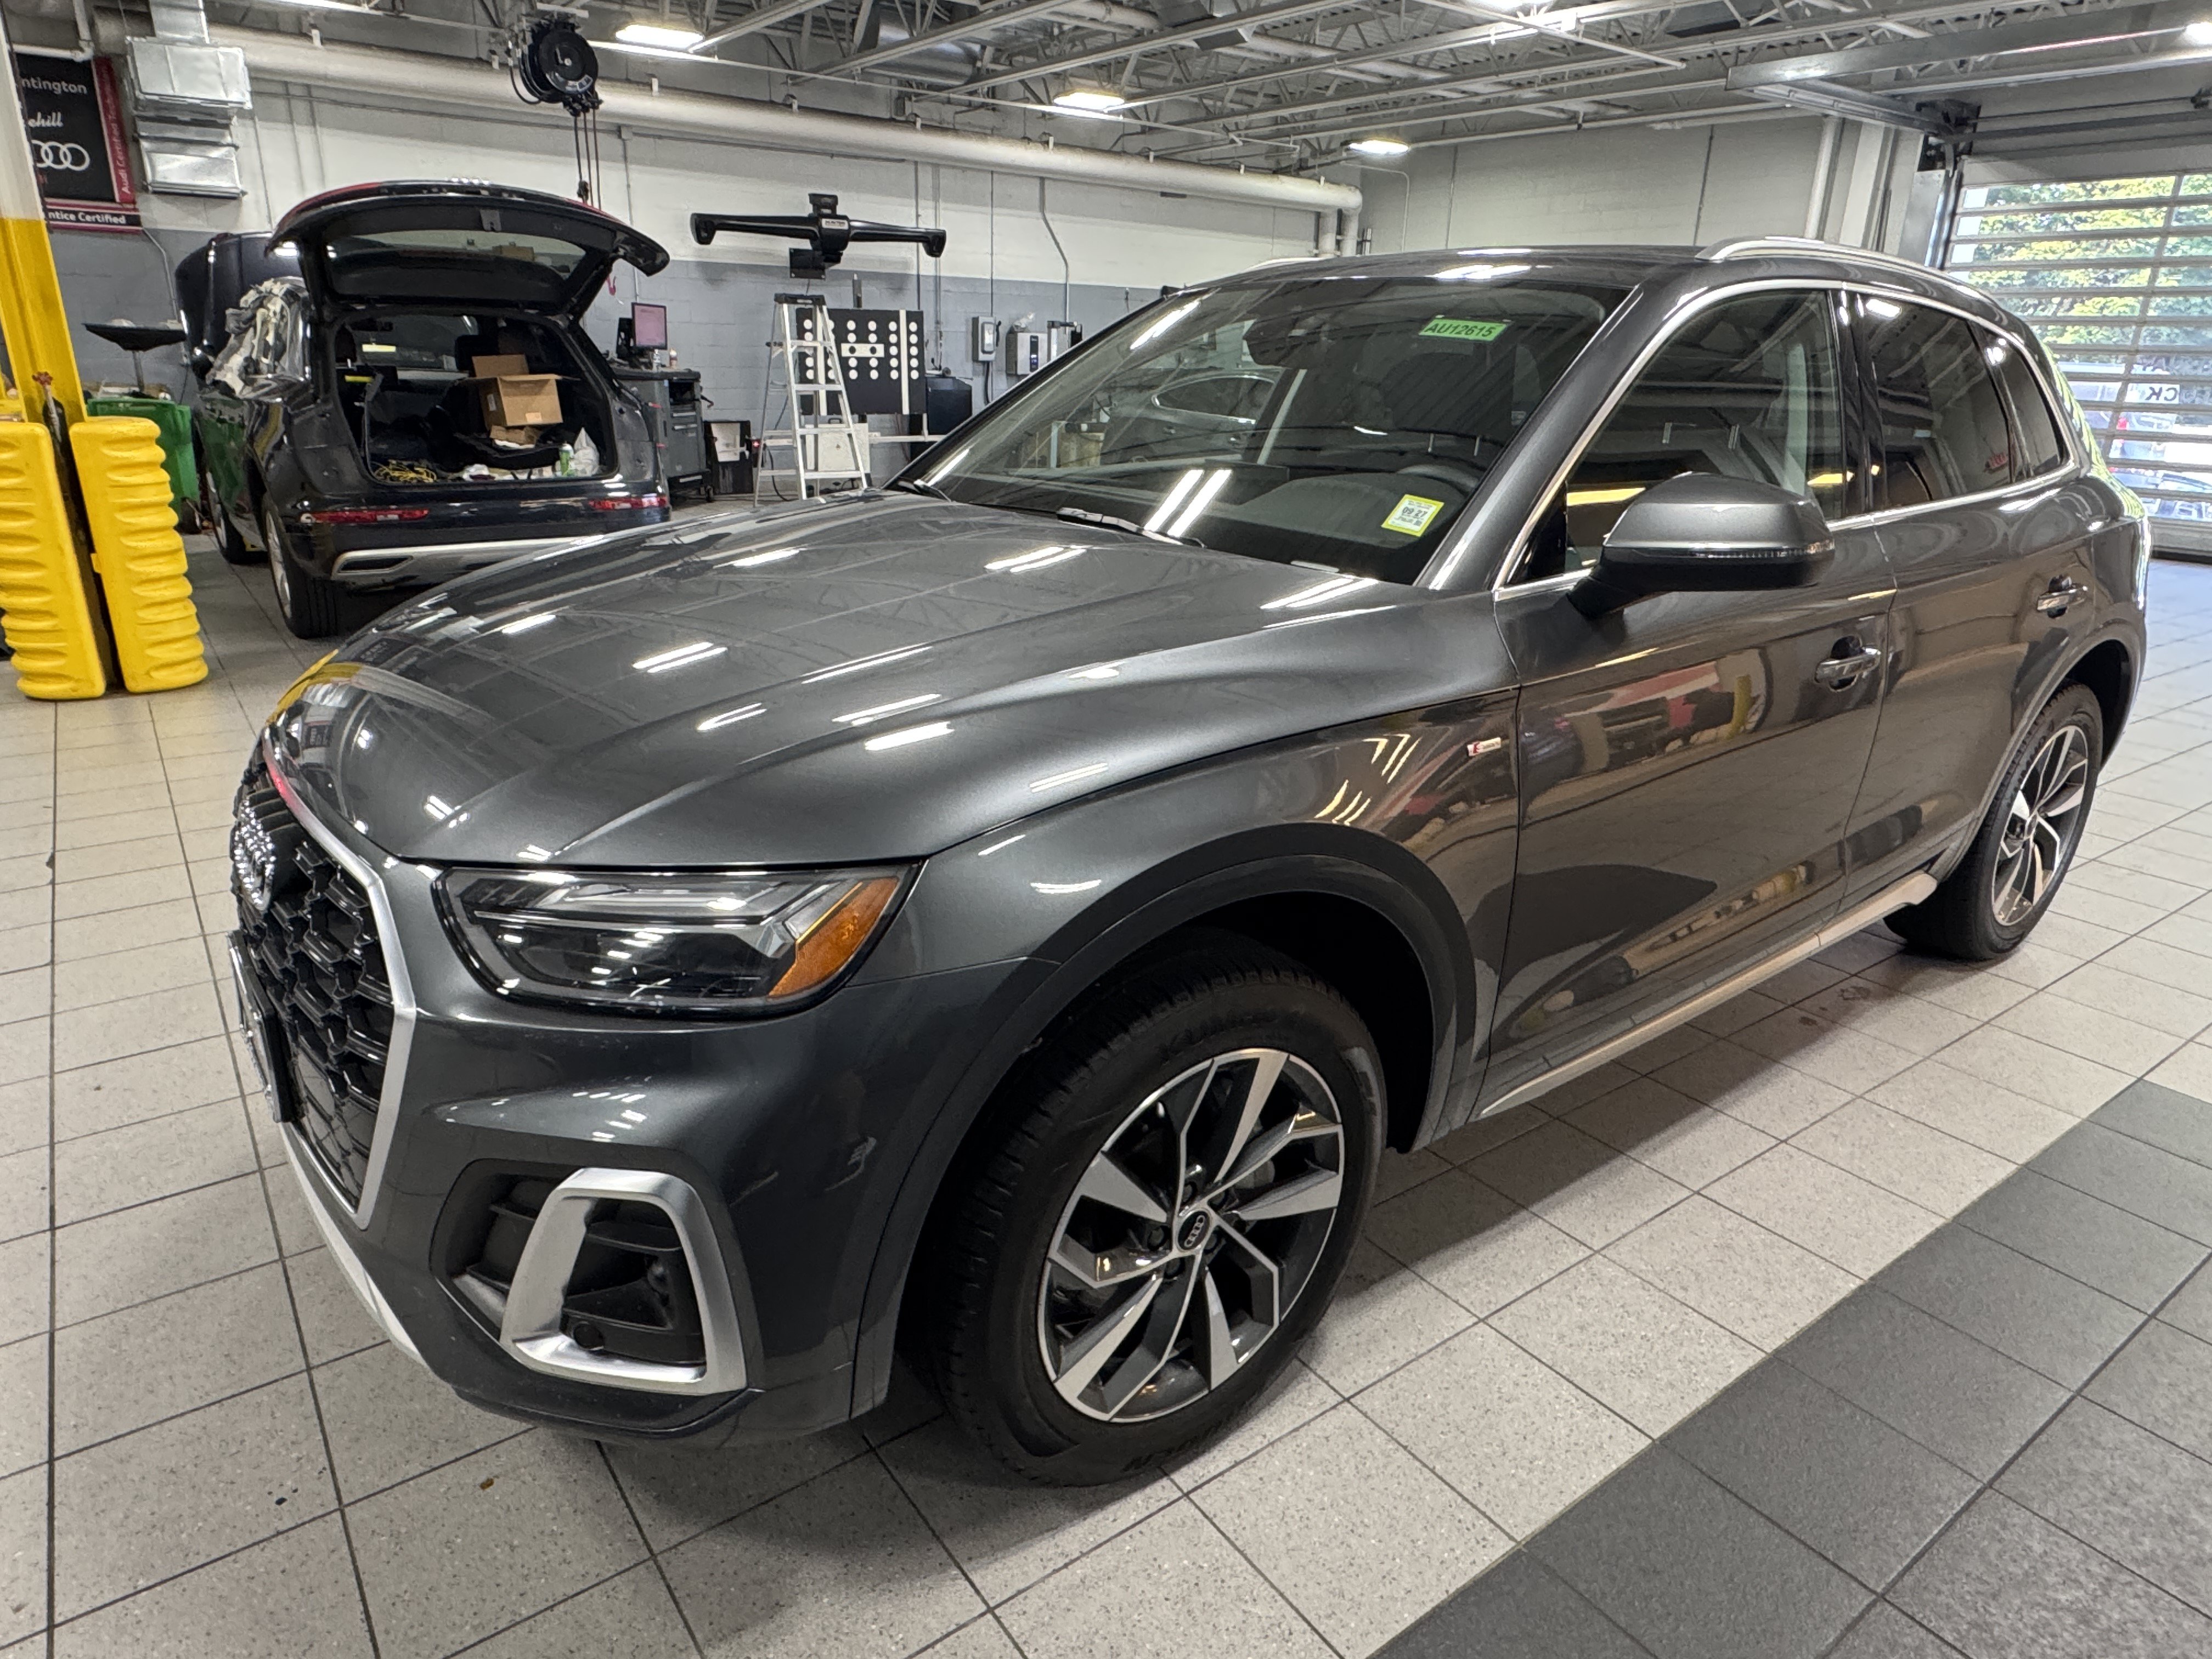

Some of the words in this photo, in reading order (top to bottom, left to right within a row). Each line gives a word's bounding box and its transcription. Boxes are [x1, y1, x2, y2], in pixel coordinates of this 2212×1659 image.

[21, 77, 88, 94] ntington
[119, 169, 131, 194] Audi
[48, 211, 76, 221] ntice
[78, 212, 126, 224] Certified
[1425, 323, 1496, 338] AU12615
